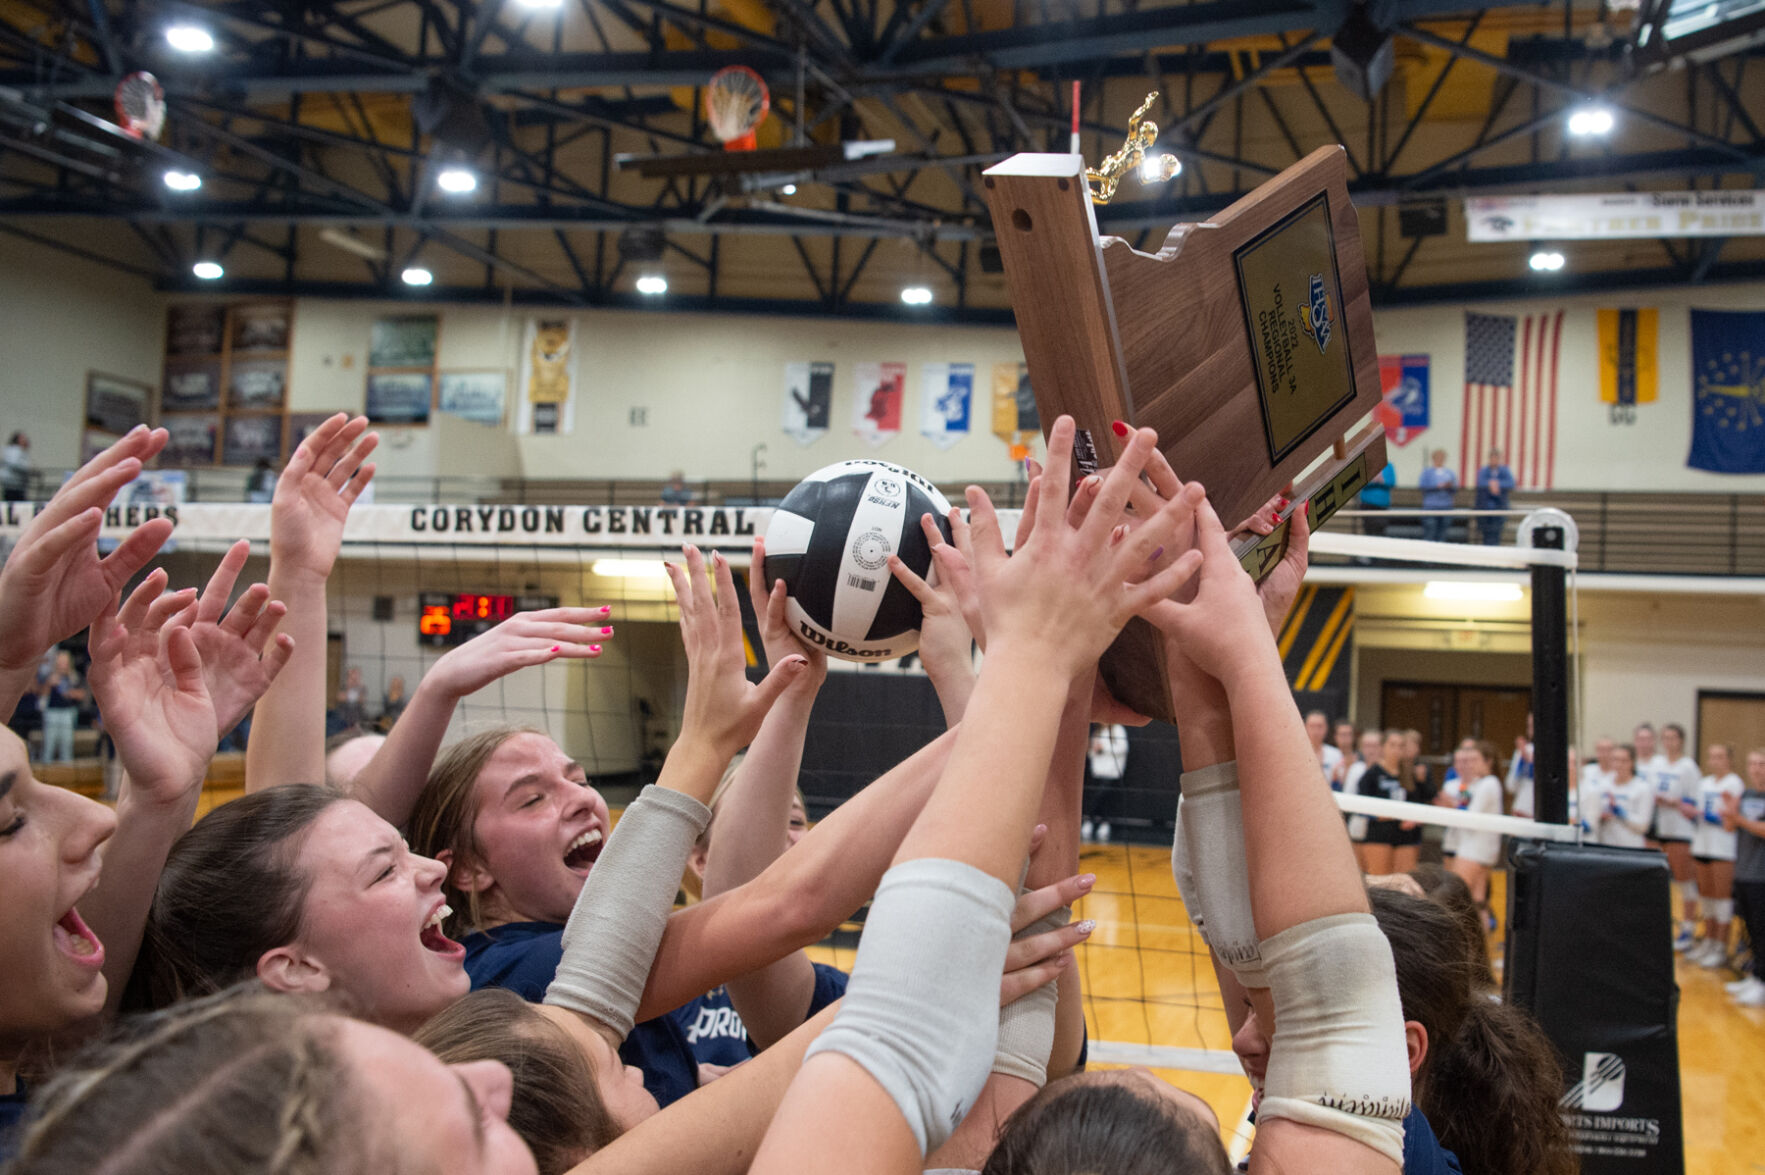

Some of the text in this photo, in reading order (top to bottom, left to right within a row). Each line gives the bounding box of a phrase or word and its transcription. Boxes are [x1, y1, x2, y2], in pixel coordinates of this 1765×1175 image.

[1288, 320, 1298, 349] 2022
[1312, 278, 1332, 345] IHSAA
[1259, 311, 1279, 394] CHAMPIONS
[1268, 310, 1286, 383] REGIONAL
[1273, 283, 1297, 394] VOLLEYBALL 3A
[411, 508, 754, 535] CORYDON CENTRAL
[800, 620, 892, 657] Wilson
[1594, 1116, 1660, 1136] IMPORTS
